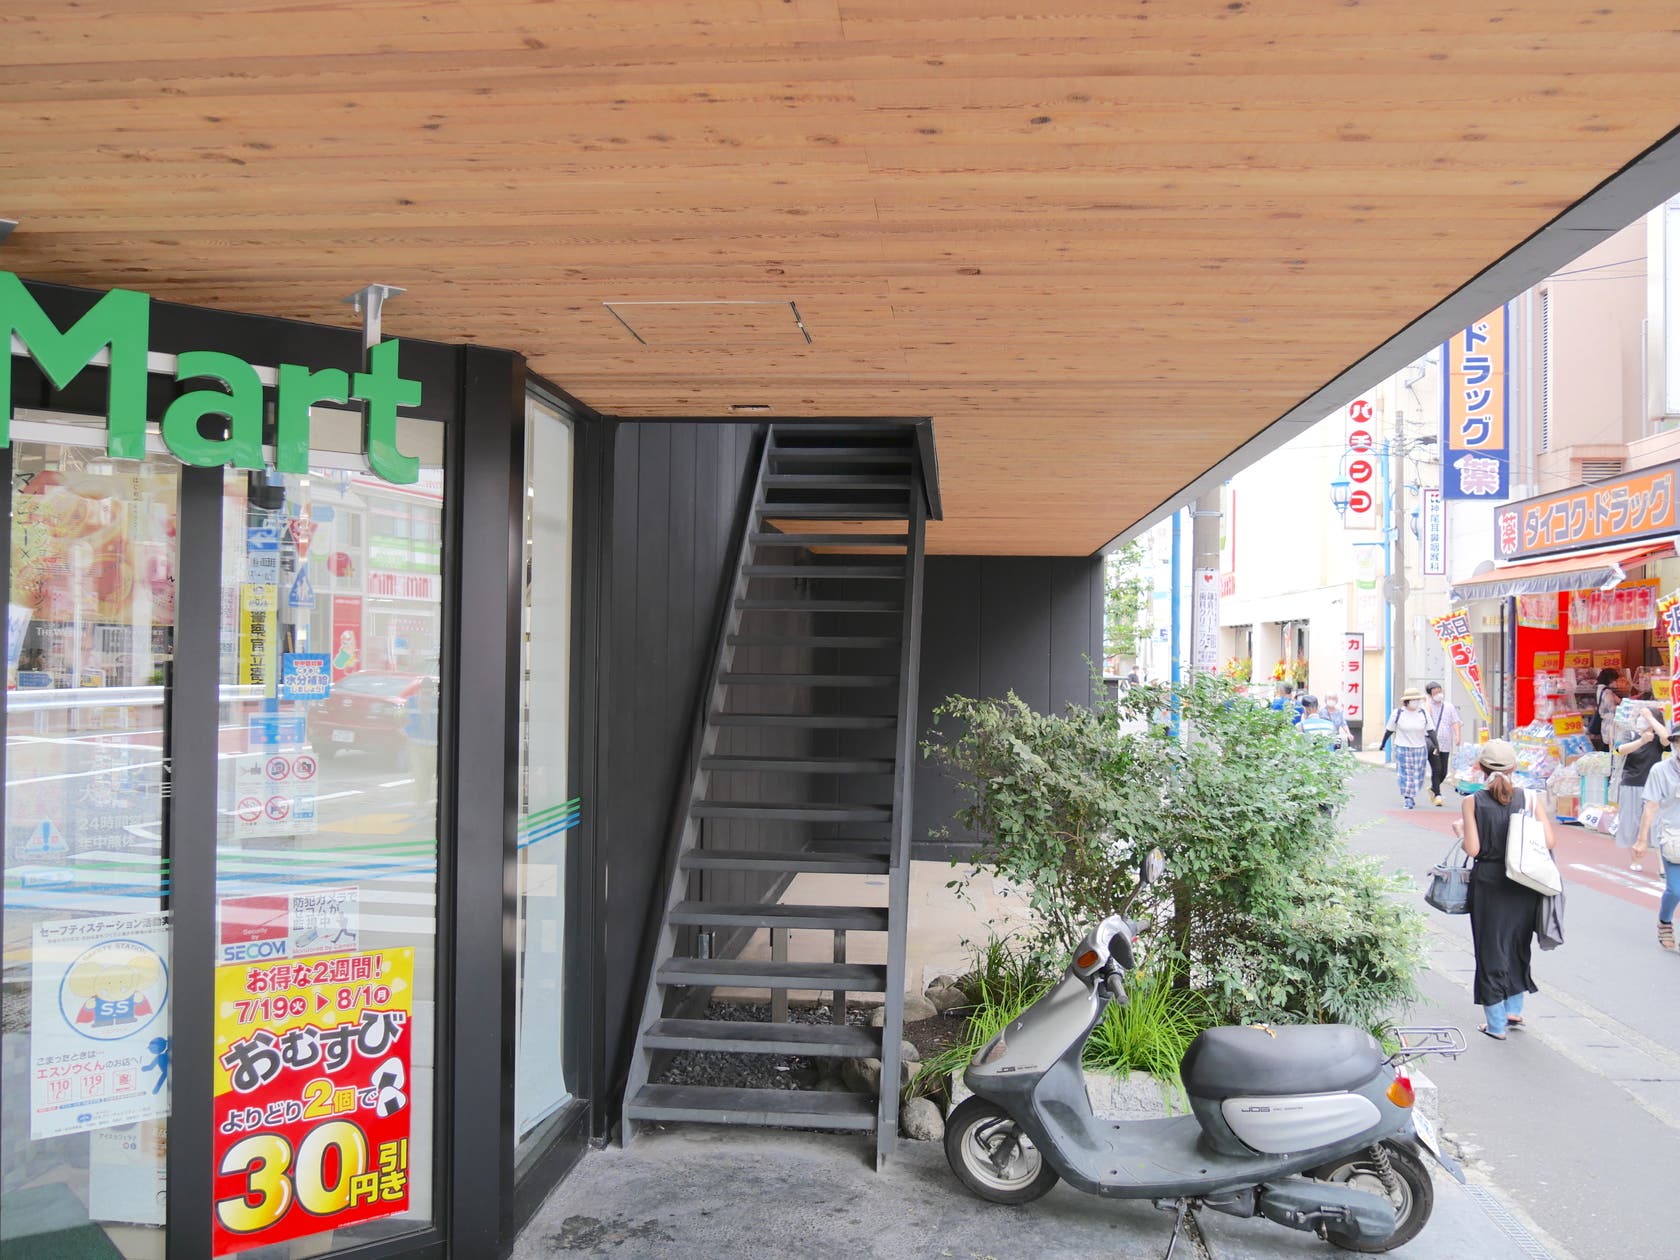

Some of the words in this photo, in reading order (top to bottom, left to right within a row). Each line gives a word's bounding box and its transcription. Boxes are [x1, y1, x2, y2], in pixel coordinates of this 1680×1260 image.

[0, 270, 422, 484] Mart
[1462, 323, 1493, 446] ドラッグ
[1349, 400, 1373, 513] パチンコ
[1453, 454, 1500, 496] 薬
[1437, 616, 1469, 638] 本日
[1347, 639, 1361, 716] カラオケ
[224, 940, 286, 962] SECOM
[243, 928, 268, 936] Security
[223, 1011, 405, 1091] おむすび
[49, 1080, 70, 1092] 110
[83, 1075, 103, 1087] 119
[221, 1078, 379, 1134] よりどり2個で
